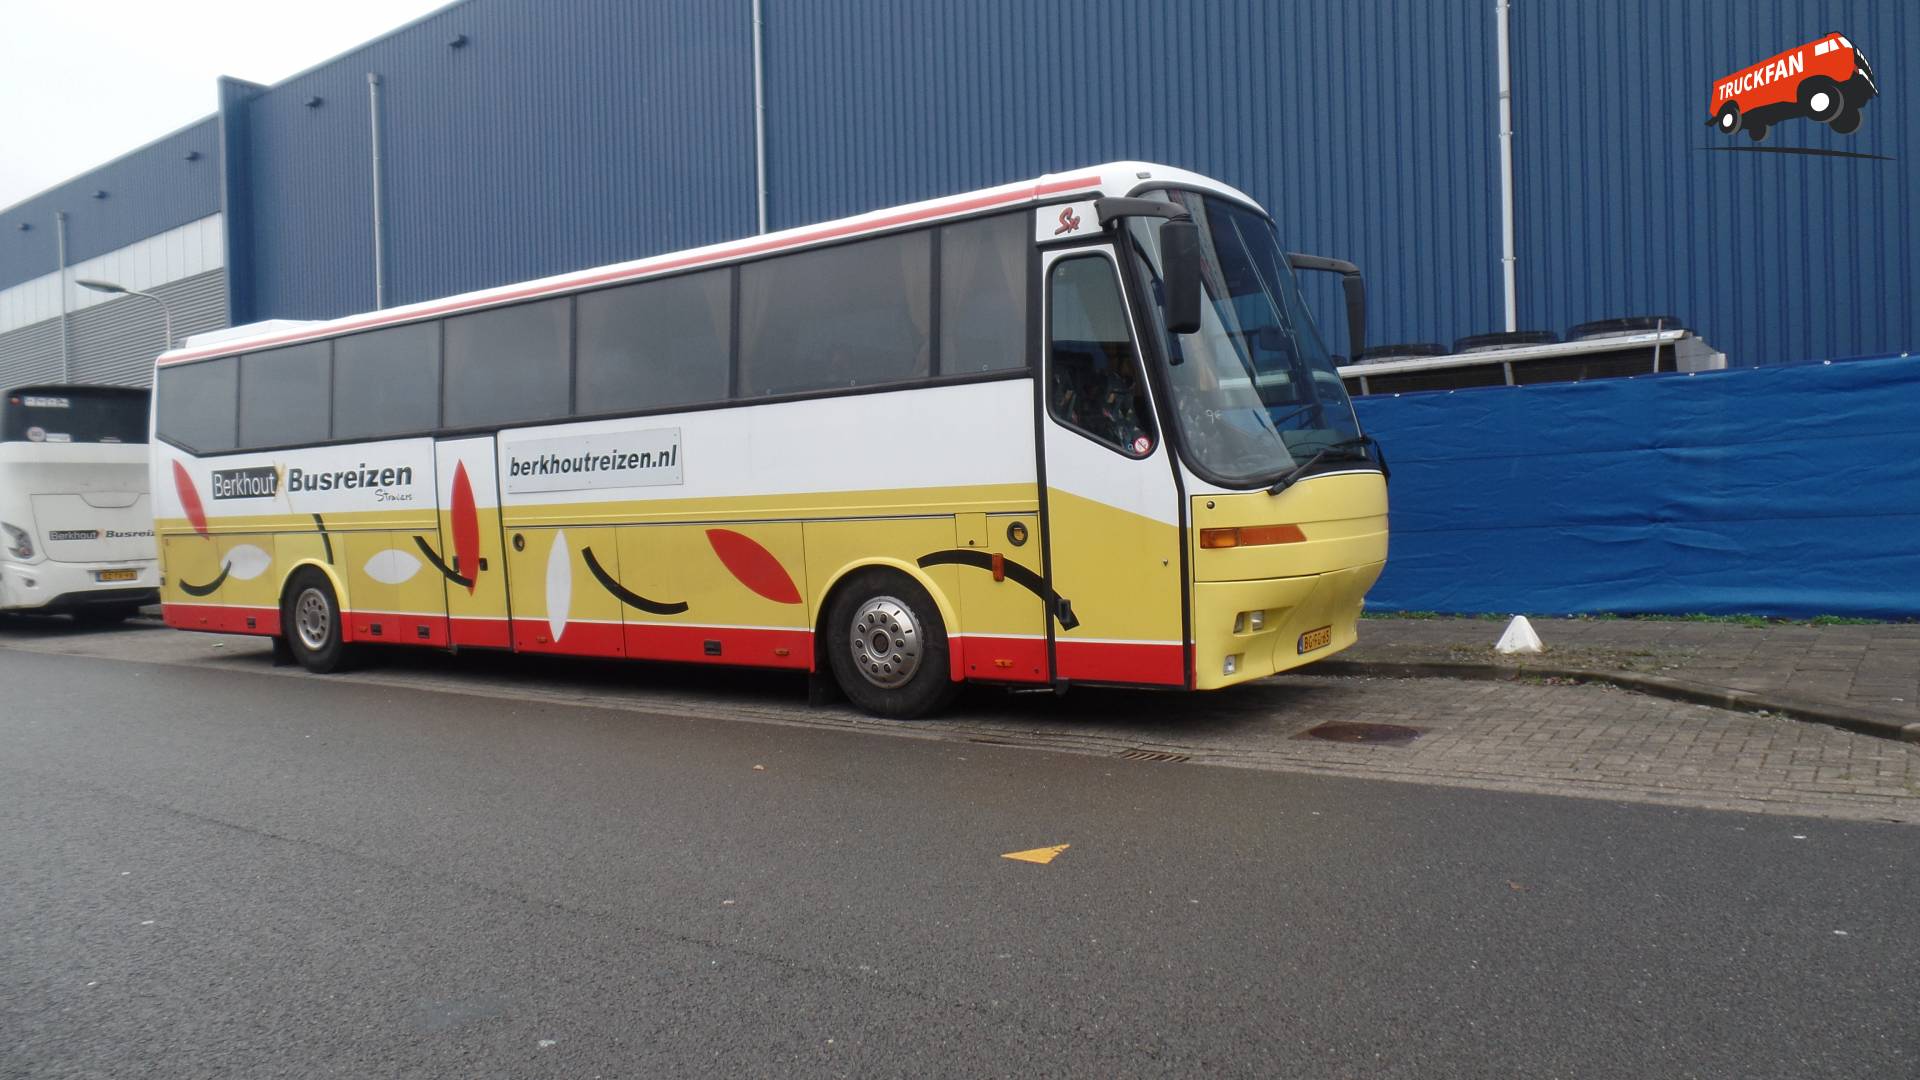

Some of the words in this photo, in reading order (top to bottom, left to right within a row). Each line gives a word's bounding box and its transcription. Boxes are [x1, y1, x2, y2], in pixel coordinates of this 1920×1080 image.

[510, 444, 677, 476] berkhoutreizen.nl
[214, 472, 275, 497] Berkhout
[287, 463, 412, 492] Busreizen
[51, 531, 96, 540] Berkhout
